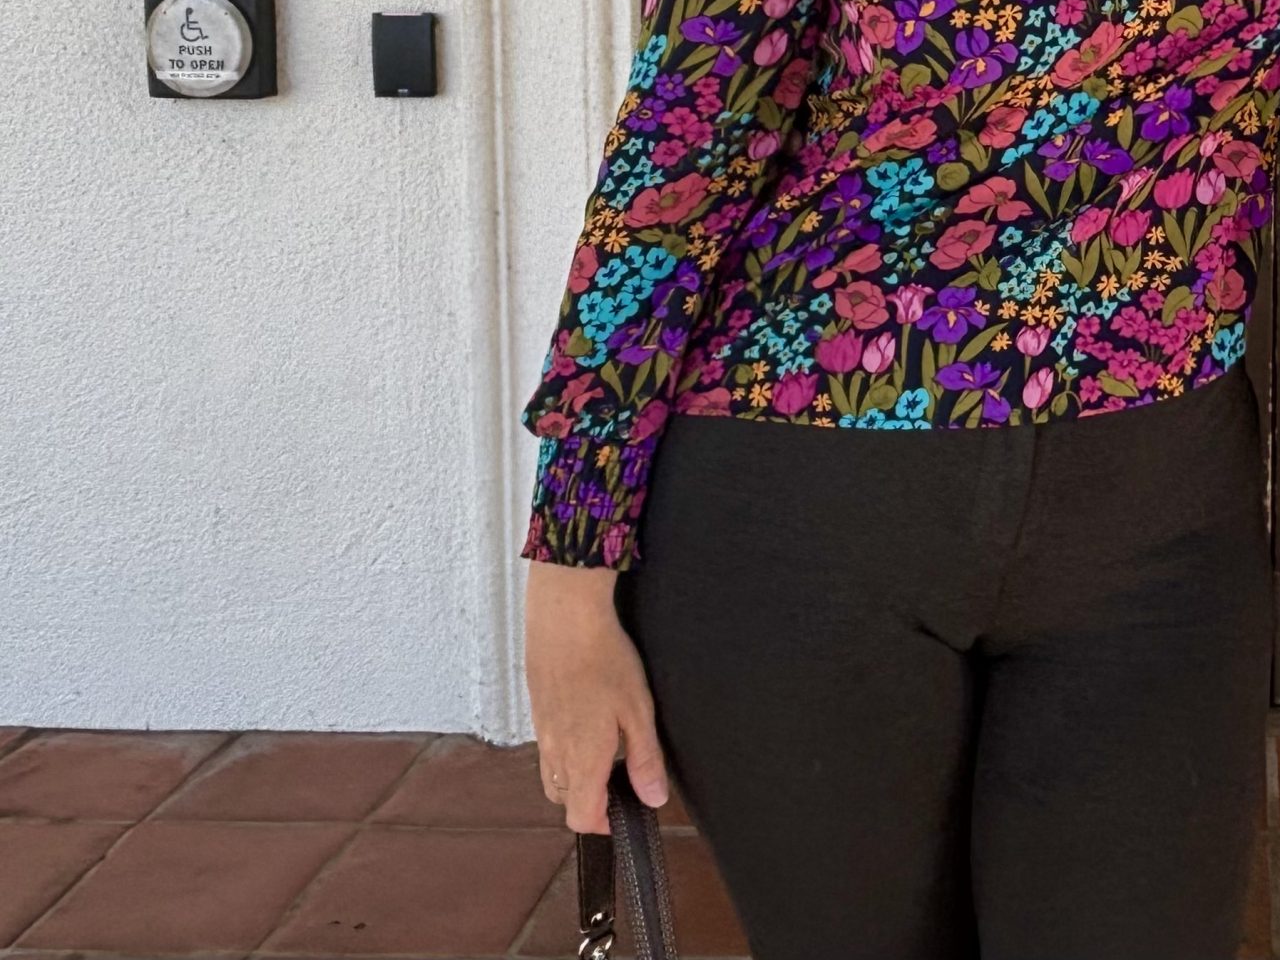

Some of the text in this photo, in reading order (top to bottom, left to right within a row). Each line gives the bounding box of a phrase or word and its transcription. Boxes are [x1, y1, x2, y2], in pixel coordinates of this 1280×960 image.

[178, 44, 213, 56] PUSH
[169, 59, 225, 71] TO OPEN
